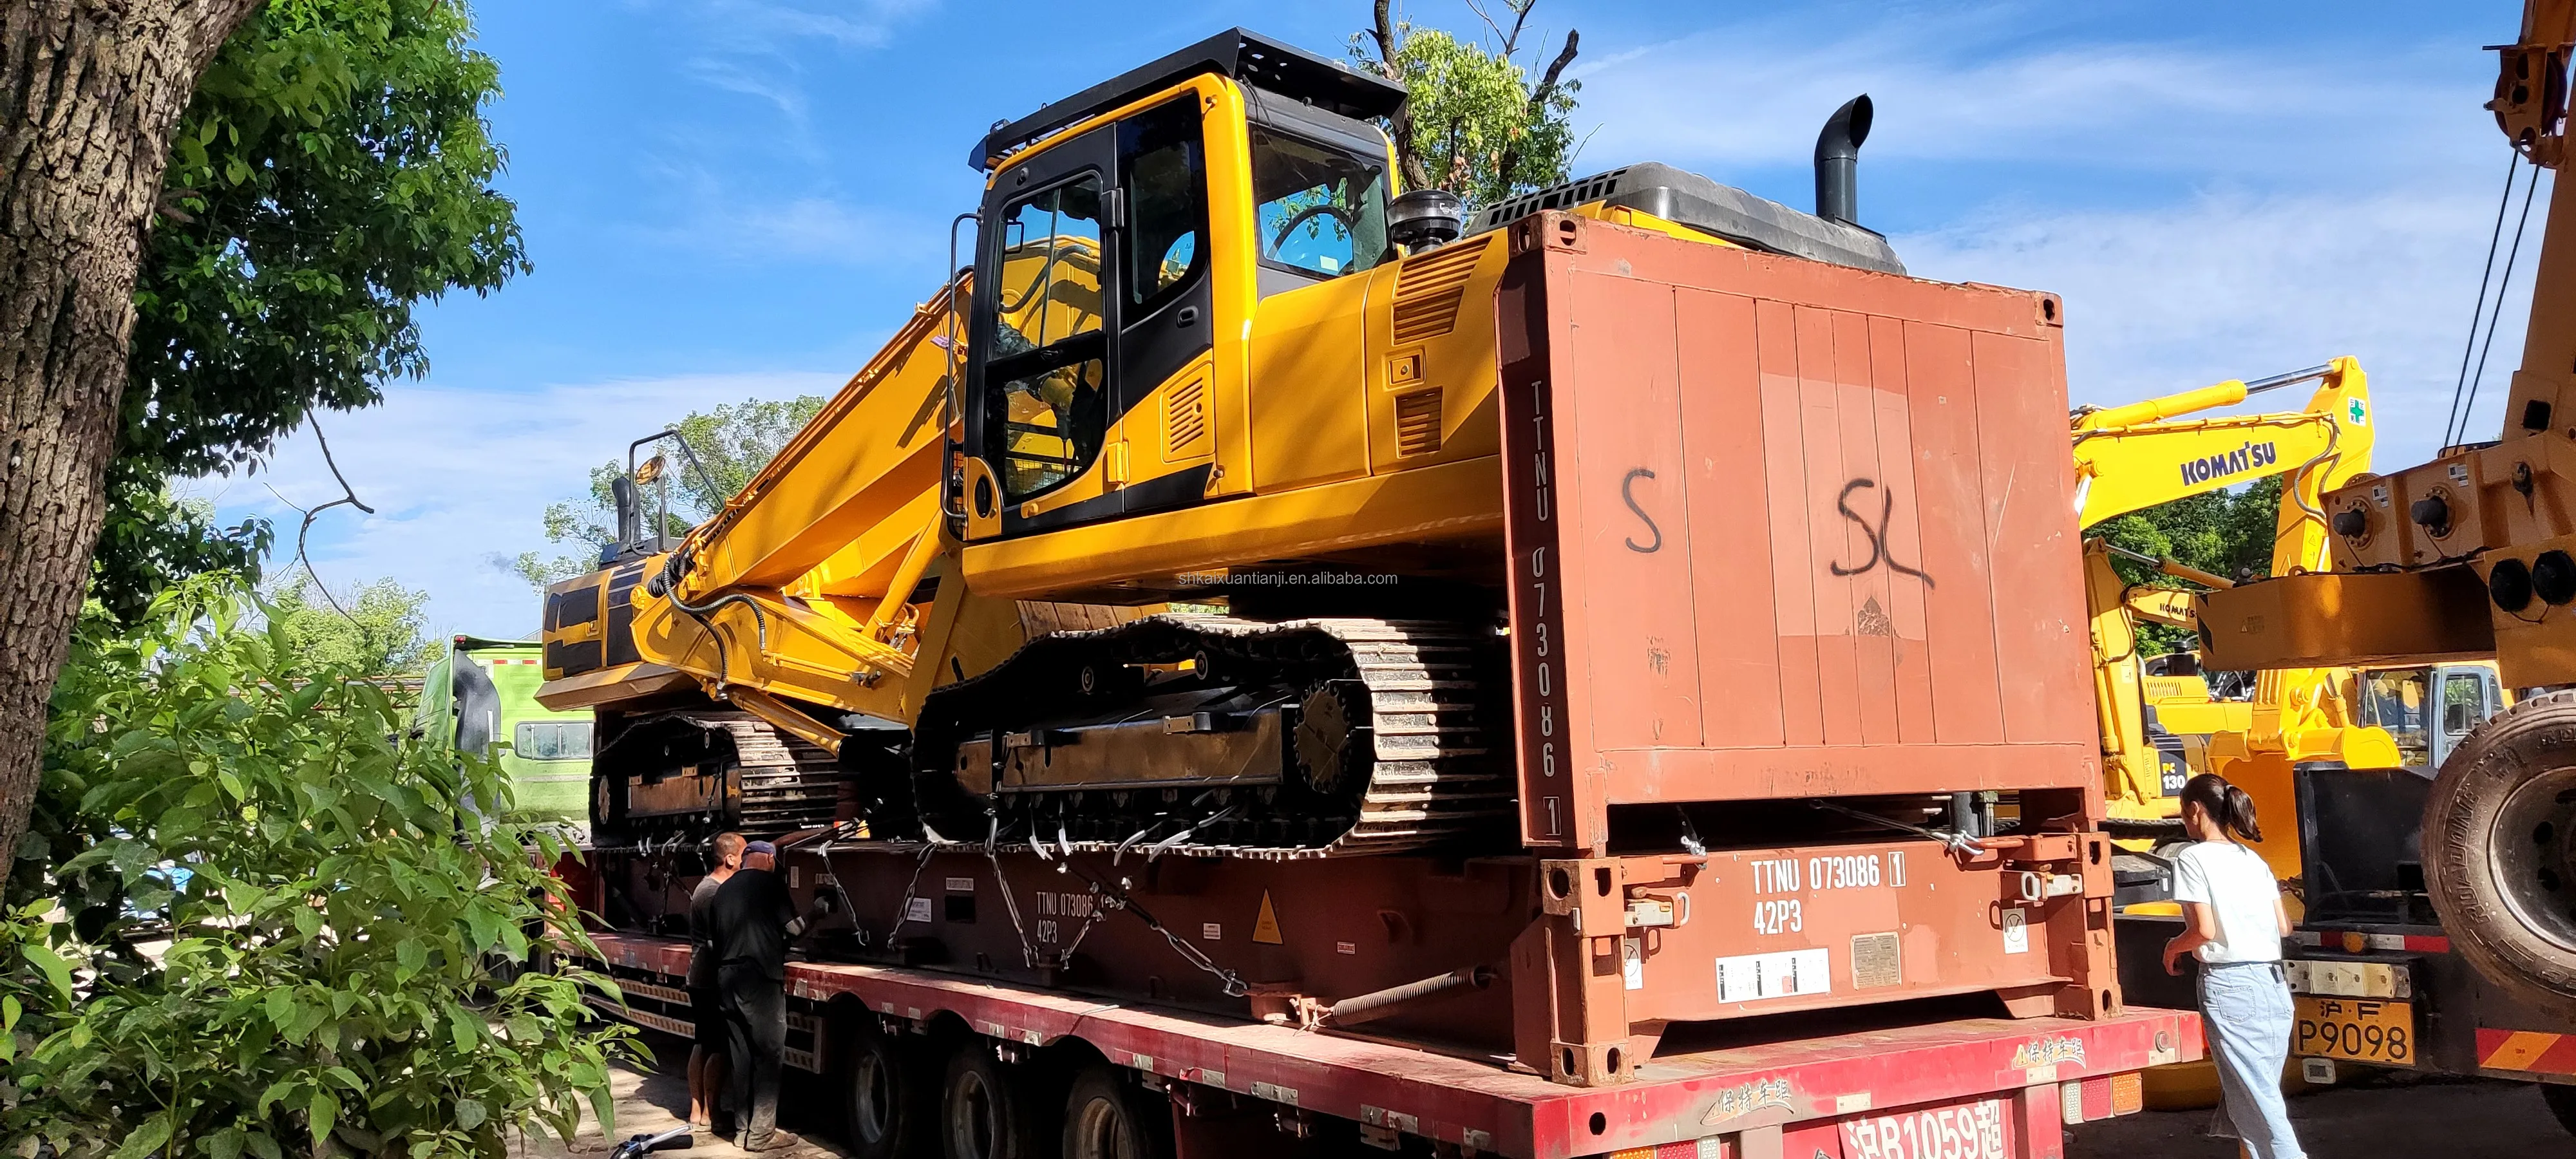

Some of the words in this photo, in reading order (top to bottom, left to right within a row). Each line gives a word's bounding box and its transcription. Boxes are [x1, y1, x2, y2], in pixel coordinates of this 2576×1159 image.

[1531, 381, 1548, 521] TTNU
[2181, 441, 2276, 486] KOMATSU
[1621, 467, 1662, 553] S
[2159, 603, 2197, 619] KOMATS
[1532, 547, 1555, 777] 073086
[2163, 762, 2175, 774] PC
[2163, 775, 2186, 789] 130
[1750, 858, 1801, 894] TTNU
[1809, 854, 1880, 889] 073086
[2447, 786, 2491, 923] ROADONE
[1036, 892, 1057, 915] TTNU
[1061, 893, 1094, 918] 073086
[1754, 899, 1802, 935] 42P3
[1037, 919, 1057, 943] 42P3
[2298, 1019, 2407, 1059] P9098
[1720, 1079, 1792, 1113] 保持车距
[1846, 1098, 2007, 1159] 沪B1059超
